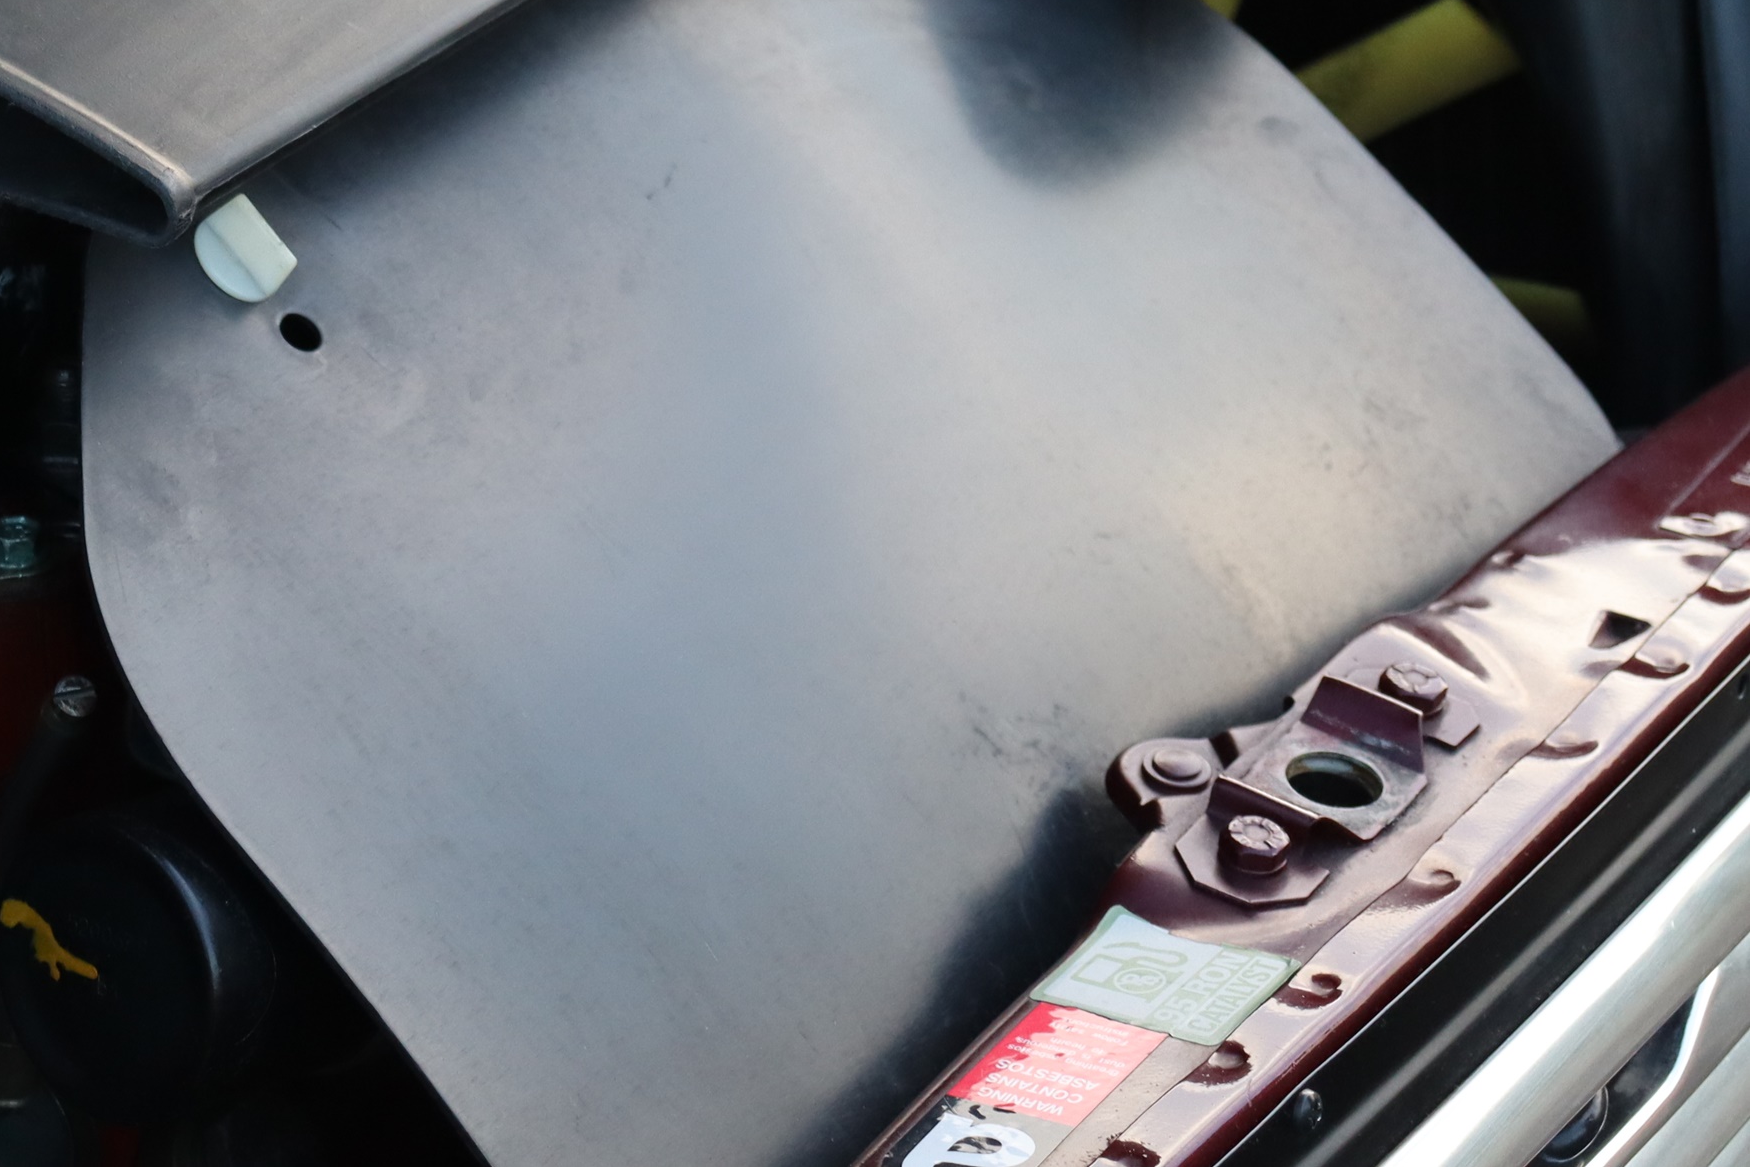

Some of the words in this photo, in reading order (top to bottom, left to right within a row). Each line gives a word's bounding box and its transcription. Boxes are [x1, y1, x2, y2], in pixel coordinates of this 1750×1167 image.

[1152, 997, 1198, 1022] 95
[1182, 950, 1250, 997] RON
[1186, 959, 1282, 1033] CATALYST
[1048, 1021, 1085, 1035] safety
[1015, 1036, 1077, 1056] dangerous
[1050, 1036, 1087, 1051] health
[1092, 1032, 1129, 1047] Follow
[1006, 1043, 1058, 1061] asbestos
[1090, 1046, 1106, 1055] to
[1064, 1057, 1120, 1078] Breathing
[1098, 1057, 1126, 1068] dust
[996, 1058, 1101, 1091] ASBESTOS
[985, 1072, 1084, 1105] CONTAINS
[977, 1086, 1065, 1117] WARNING
